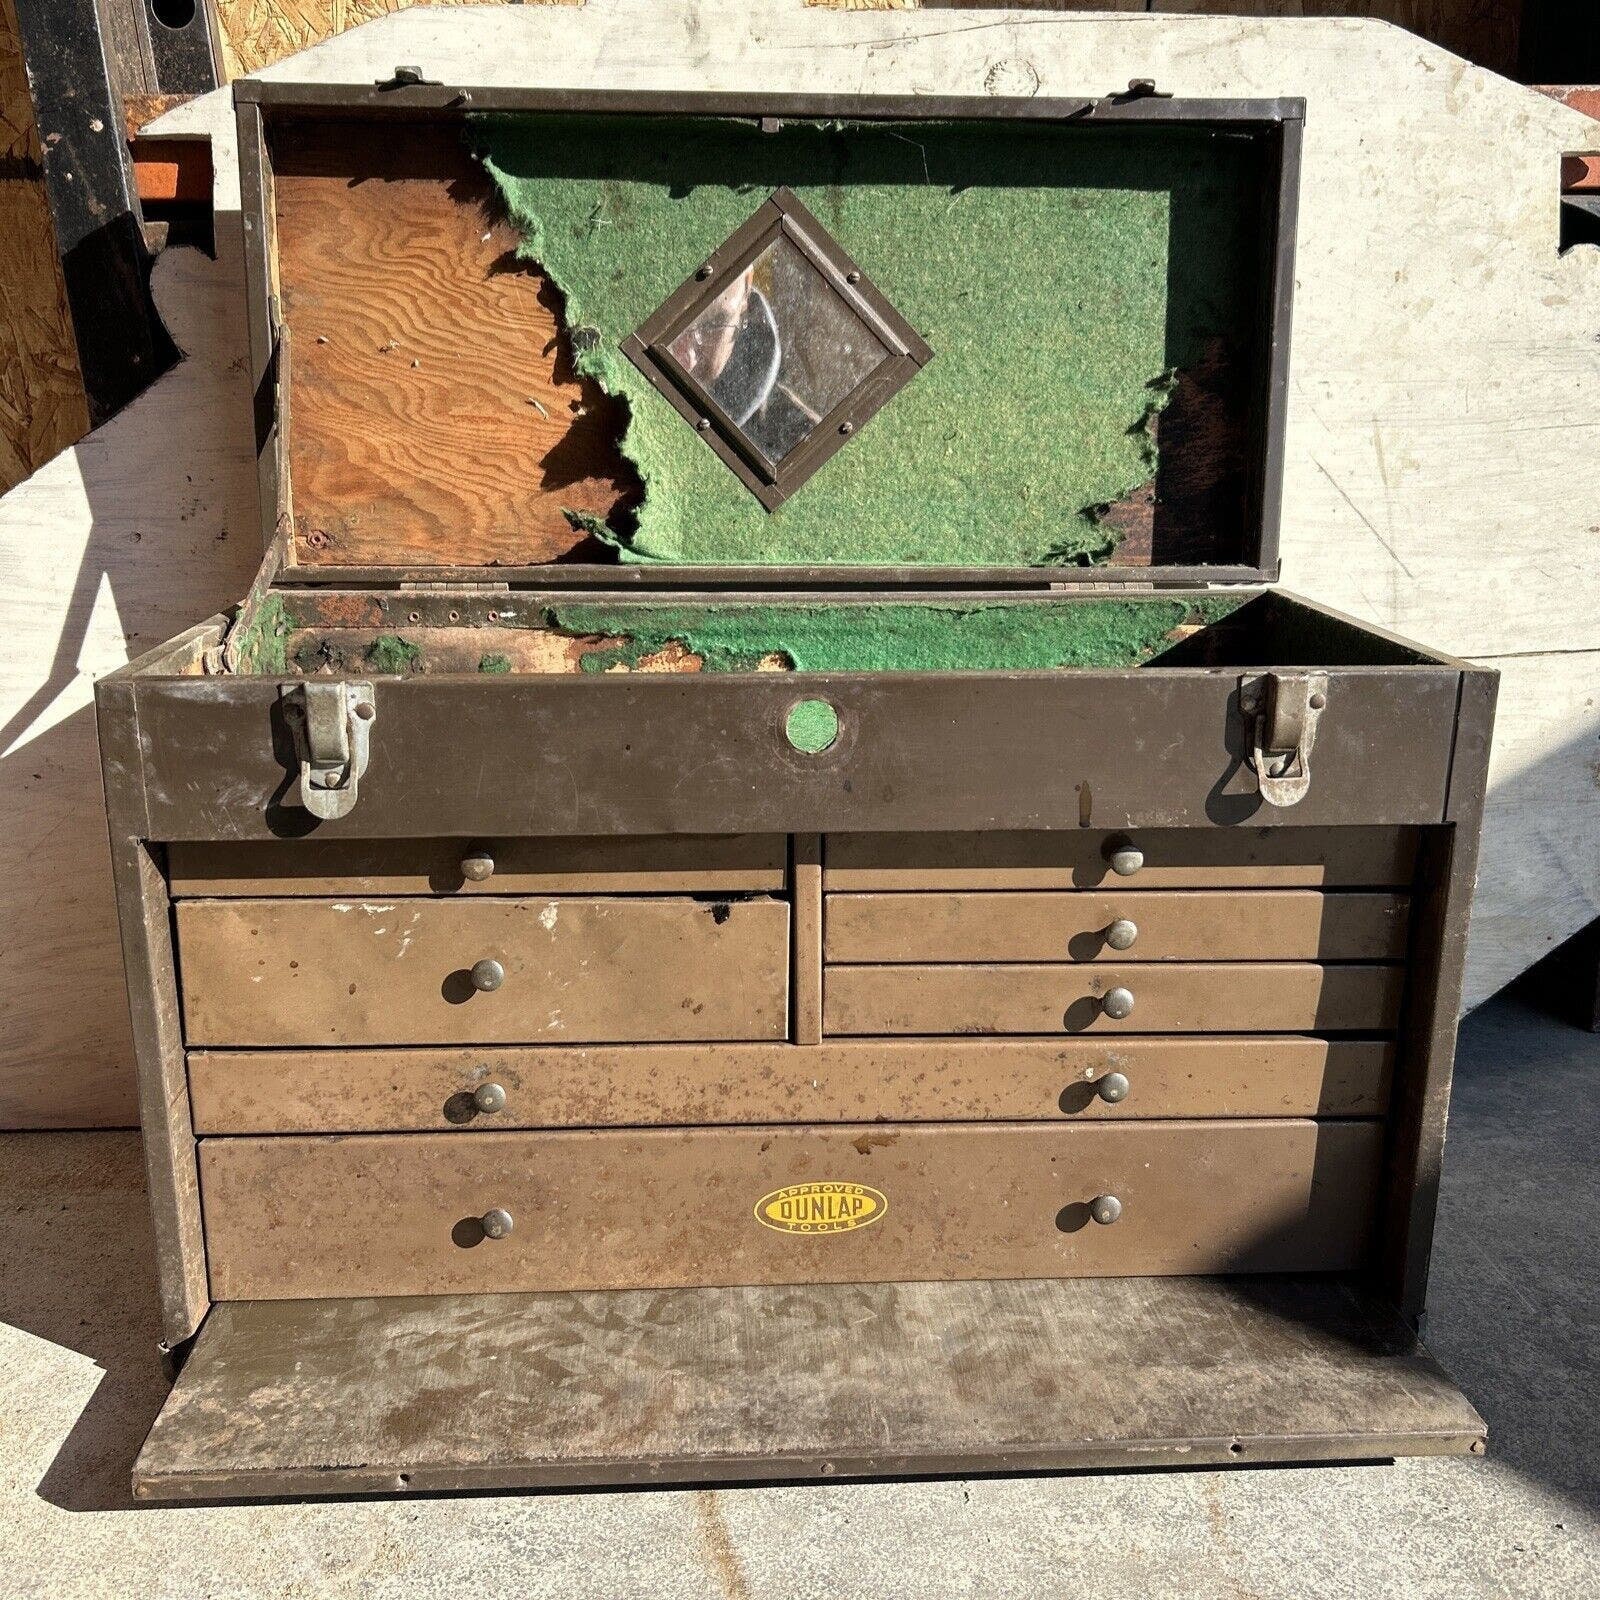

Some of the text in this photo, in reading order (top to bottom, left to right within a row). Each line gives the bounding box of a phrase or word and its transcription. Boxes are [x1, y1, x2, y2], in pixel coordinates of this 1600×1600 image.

[778, 1184, 864, 1199] APPROVED
[780, 1196, 863, 1220] DUNLAP
[787, 1219, 857, 1232] TOOLS
